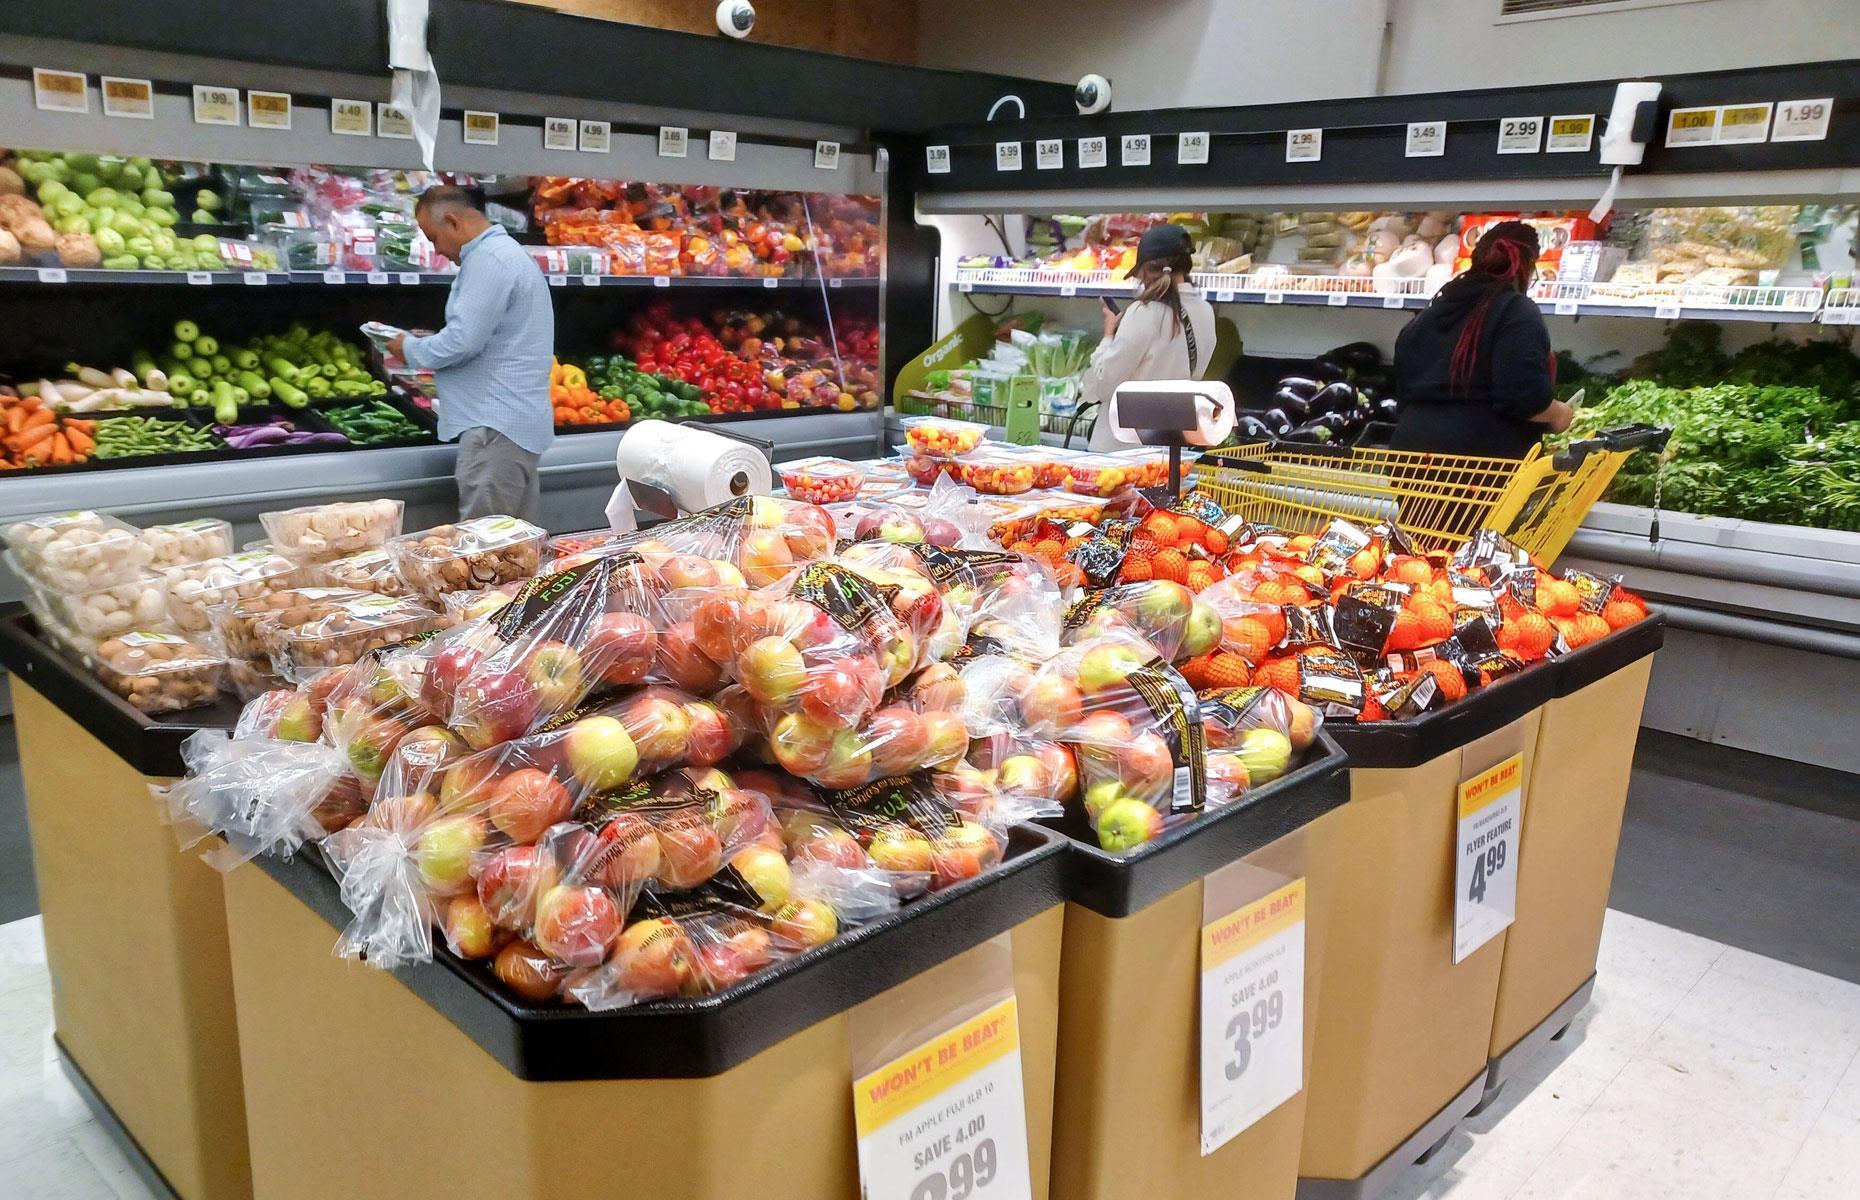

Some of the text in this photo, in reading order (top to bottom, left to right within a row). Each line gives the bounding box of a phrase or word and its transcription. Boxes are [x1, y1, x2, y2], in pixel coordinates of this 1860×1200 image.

[202, 92, 228, 105] 1.99
[338, 104, 361, 116] 4.49
[1784, 104, 1824, 122] 1.99
[1412, 127, 1436, 138] 3.49
[1505, 121, 1537, 136] 2.99
[1125, 139, 1147, 150] 4.99
[1184, 137, 1201, 147] 3.49
[1292, 134, 1313, 145] 2.99
[929, 149, 946, 160] 3.99
[1000, 146, 1018, 157] 5.99
[1040, 143, 1060, 155] 3.49
[923, 333, 964, 368] Organic
[1464, 765, 1516, 800] WON'T BE BEAT
[1466, 834, 1485, 856] FLYER
[1486, 818, 1512, 844] FEATURE
[1211, 892, 1294, 945] WON'T BE BEAT
[1231, 969, 1279, 1008] SAVE 4.00
[868, 1021, 1000, 1104] WON'T BE BEAT
[915, 1110, 945, 1136] APPLE
[945, 1101, 966, 1119] FUJI
[914, 1114, 986, 1171] SAVE 4.00
